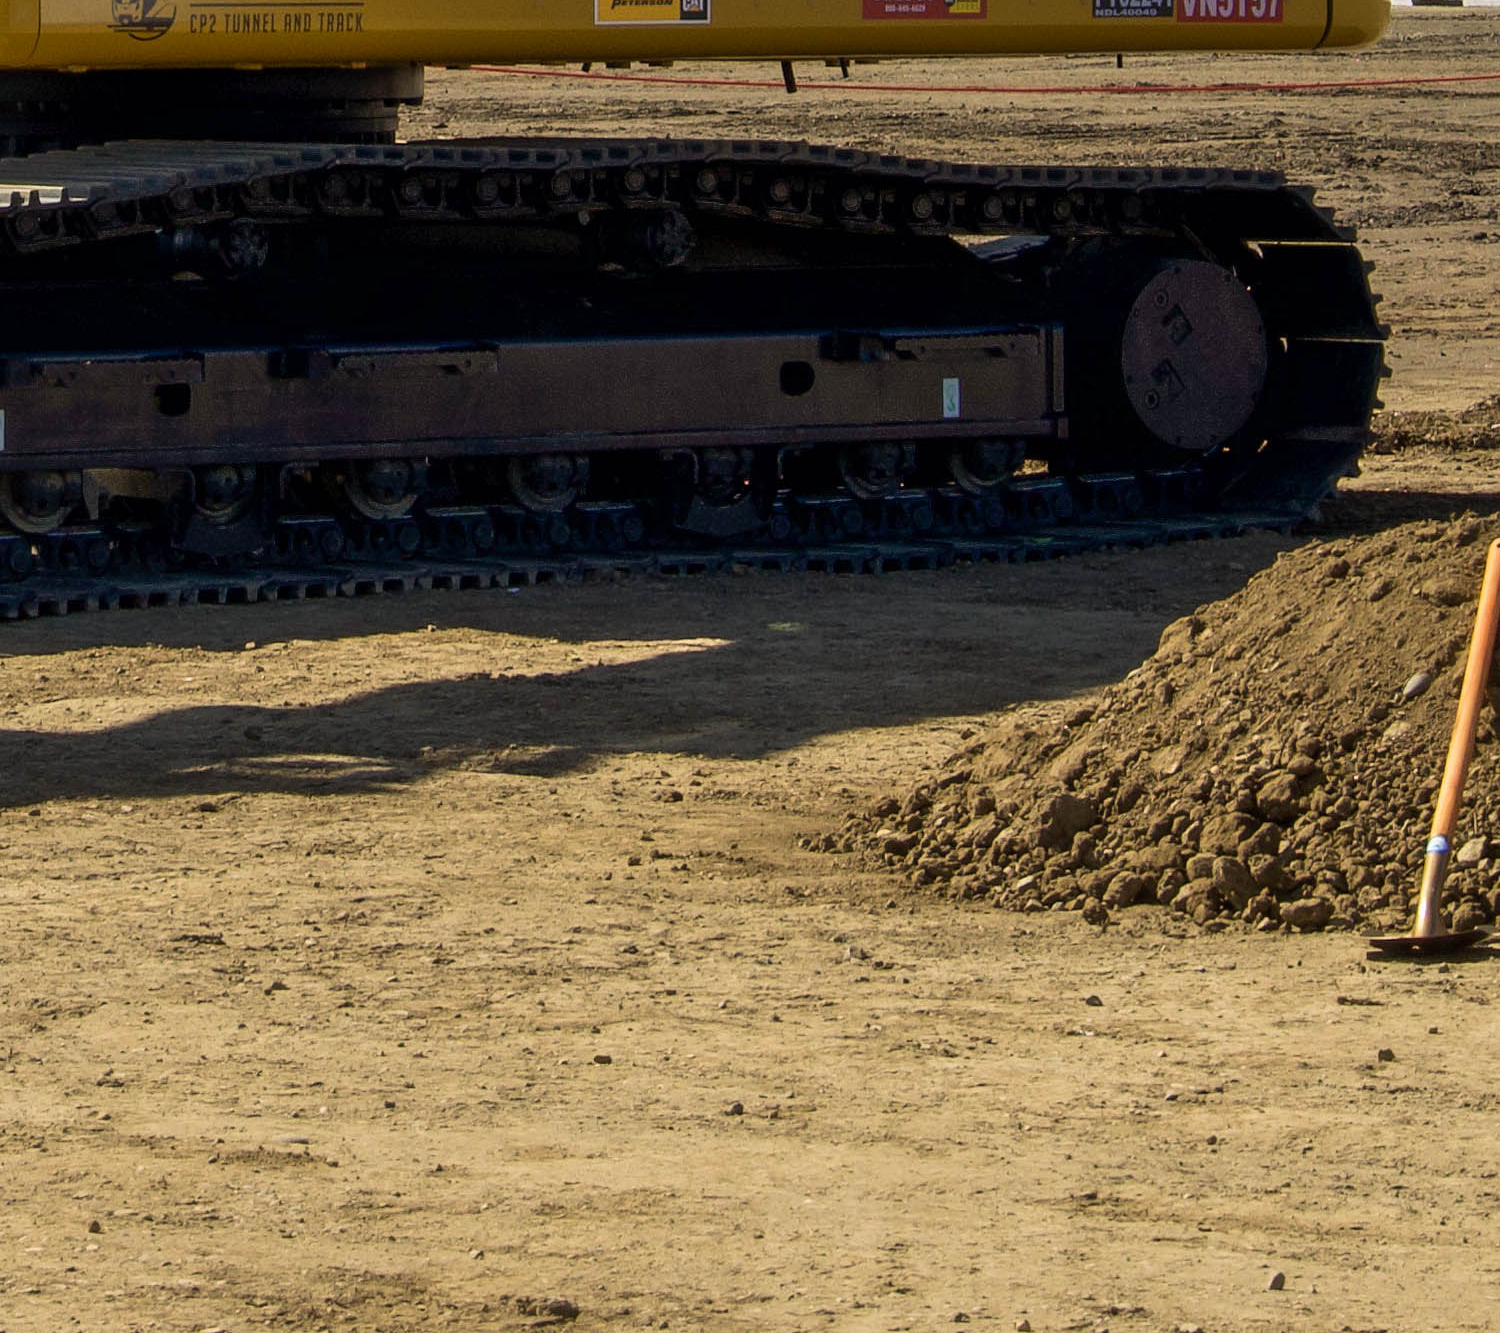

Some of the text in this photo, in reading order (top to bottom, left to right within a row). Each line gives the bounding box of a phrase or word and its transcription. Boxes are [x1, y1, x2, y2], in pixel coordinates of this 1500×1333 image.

[190, 13, 363, 34] CP2 TUNNEL AND TRACK
